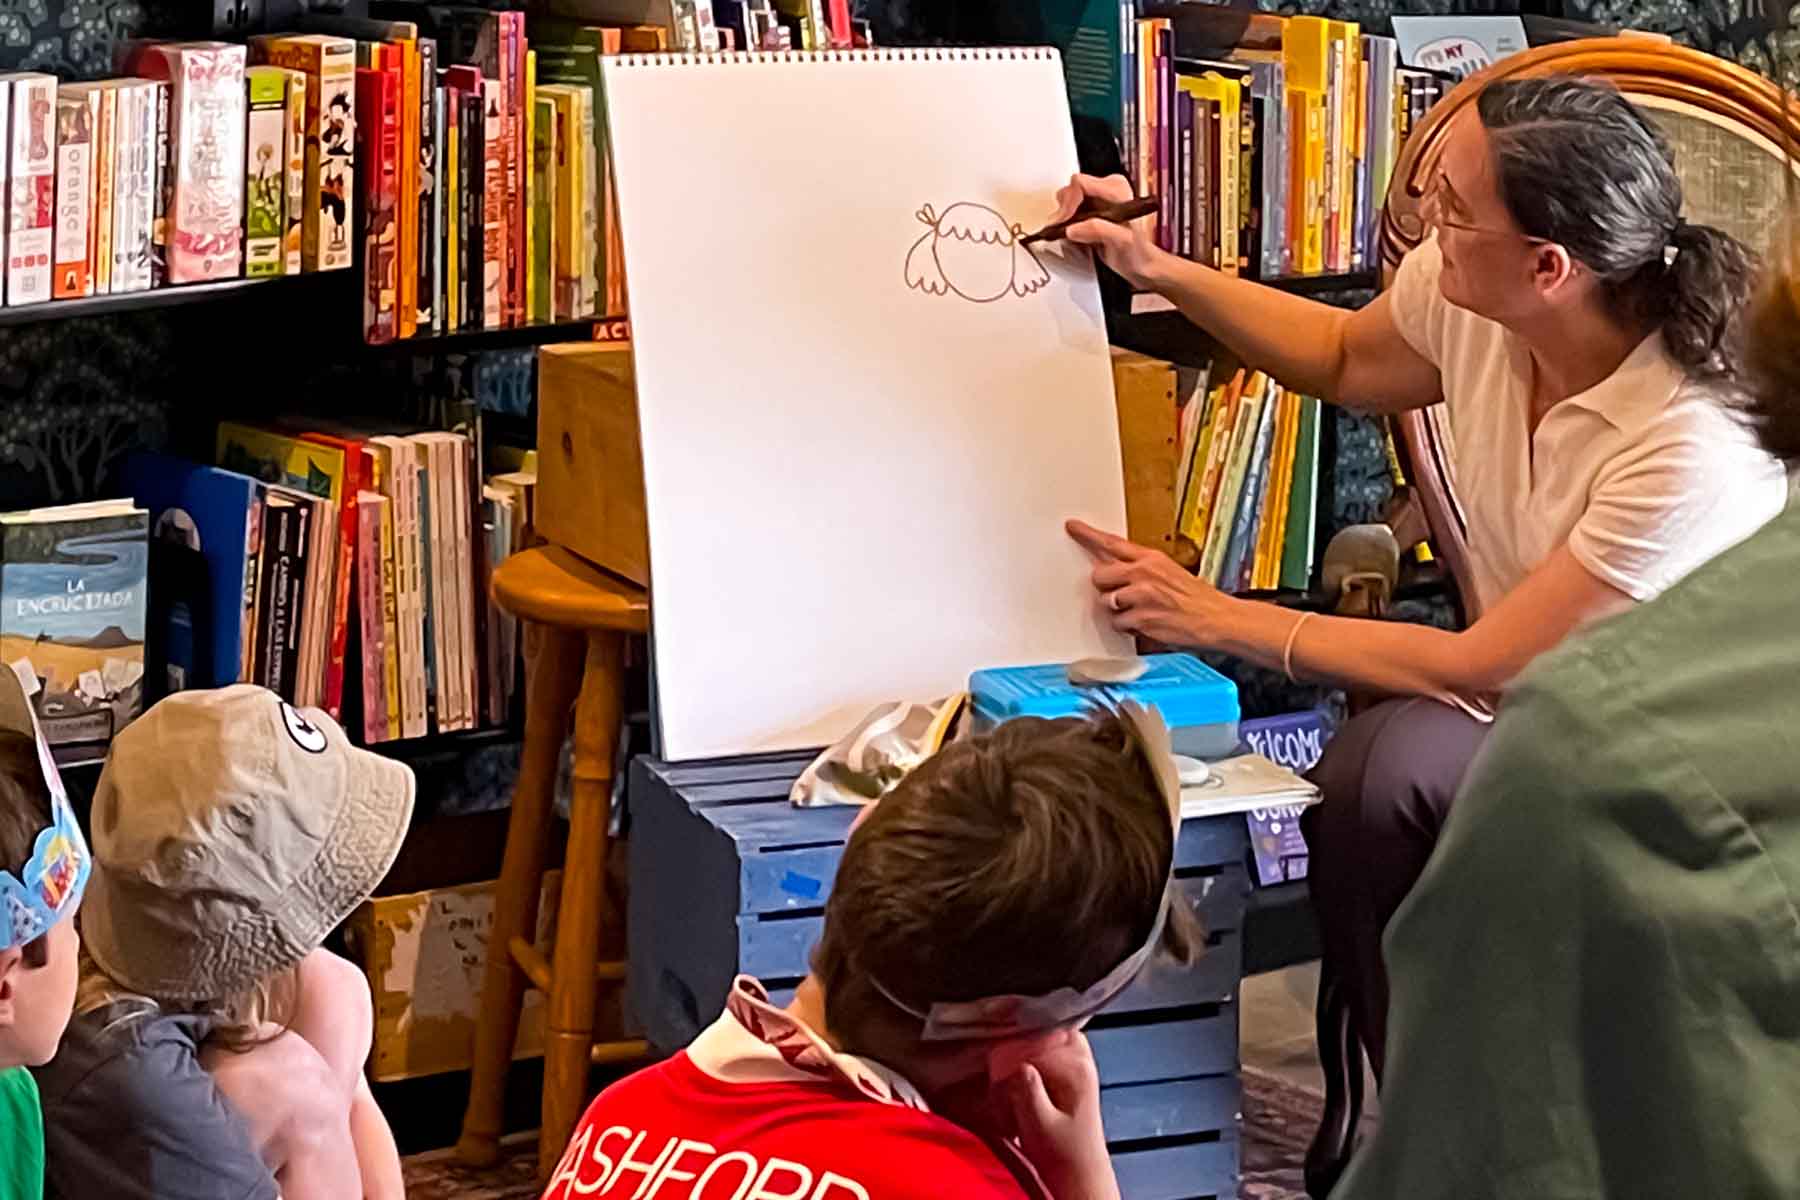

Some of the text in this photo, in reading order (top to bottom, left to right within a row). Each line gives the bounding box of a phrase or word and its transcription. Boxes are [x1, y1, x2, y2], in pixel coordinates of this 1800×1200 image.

[1444, 44, 1464, 60] MY
[61, 149, 81, 231] orange
[67, 579, 85, 593] LA
[275, 619, 286, 643] LAS
